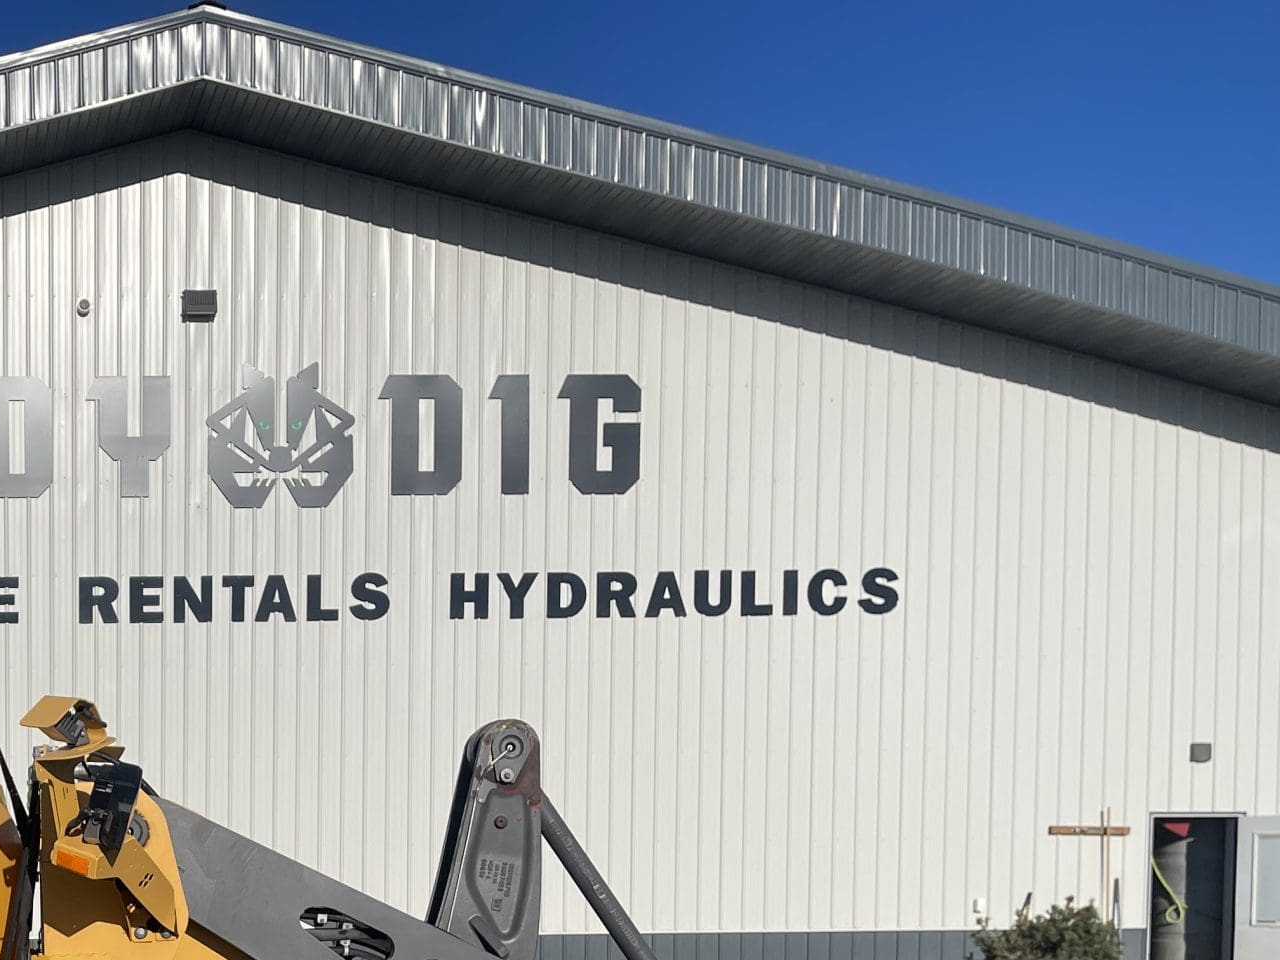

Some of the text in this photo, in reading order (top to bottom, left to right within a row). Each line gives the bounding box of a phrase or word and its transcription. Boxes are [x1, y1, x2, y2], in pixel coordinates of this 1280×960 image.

[378, 374, 642, 496] DIG
[79, 572, 390, 625] RENTALS
[450, 567, 899, 620] HYDRAULICS
